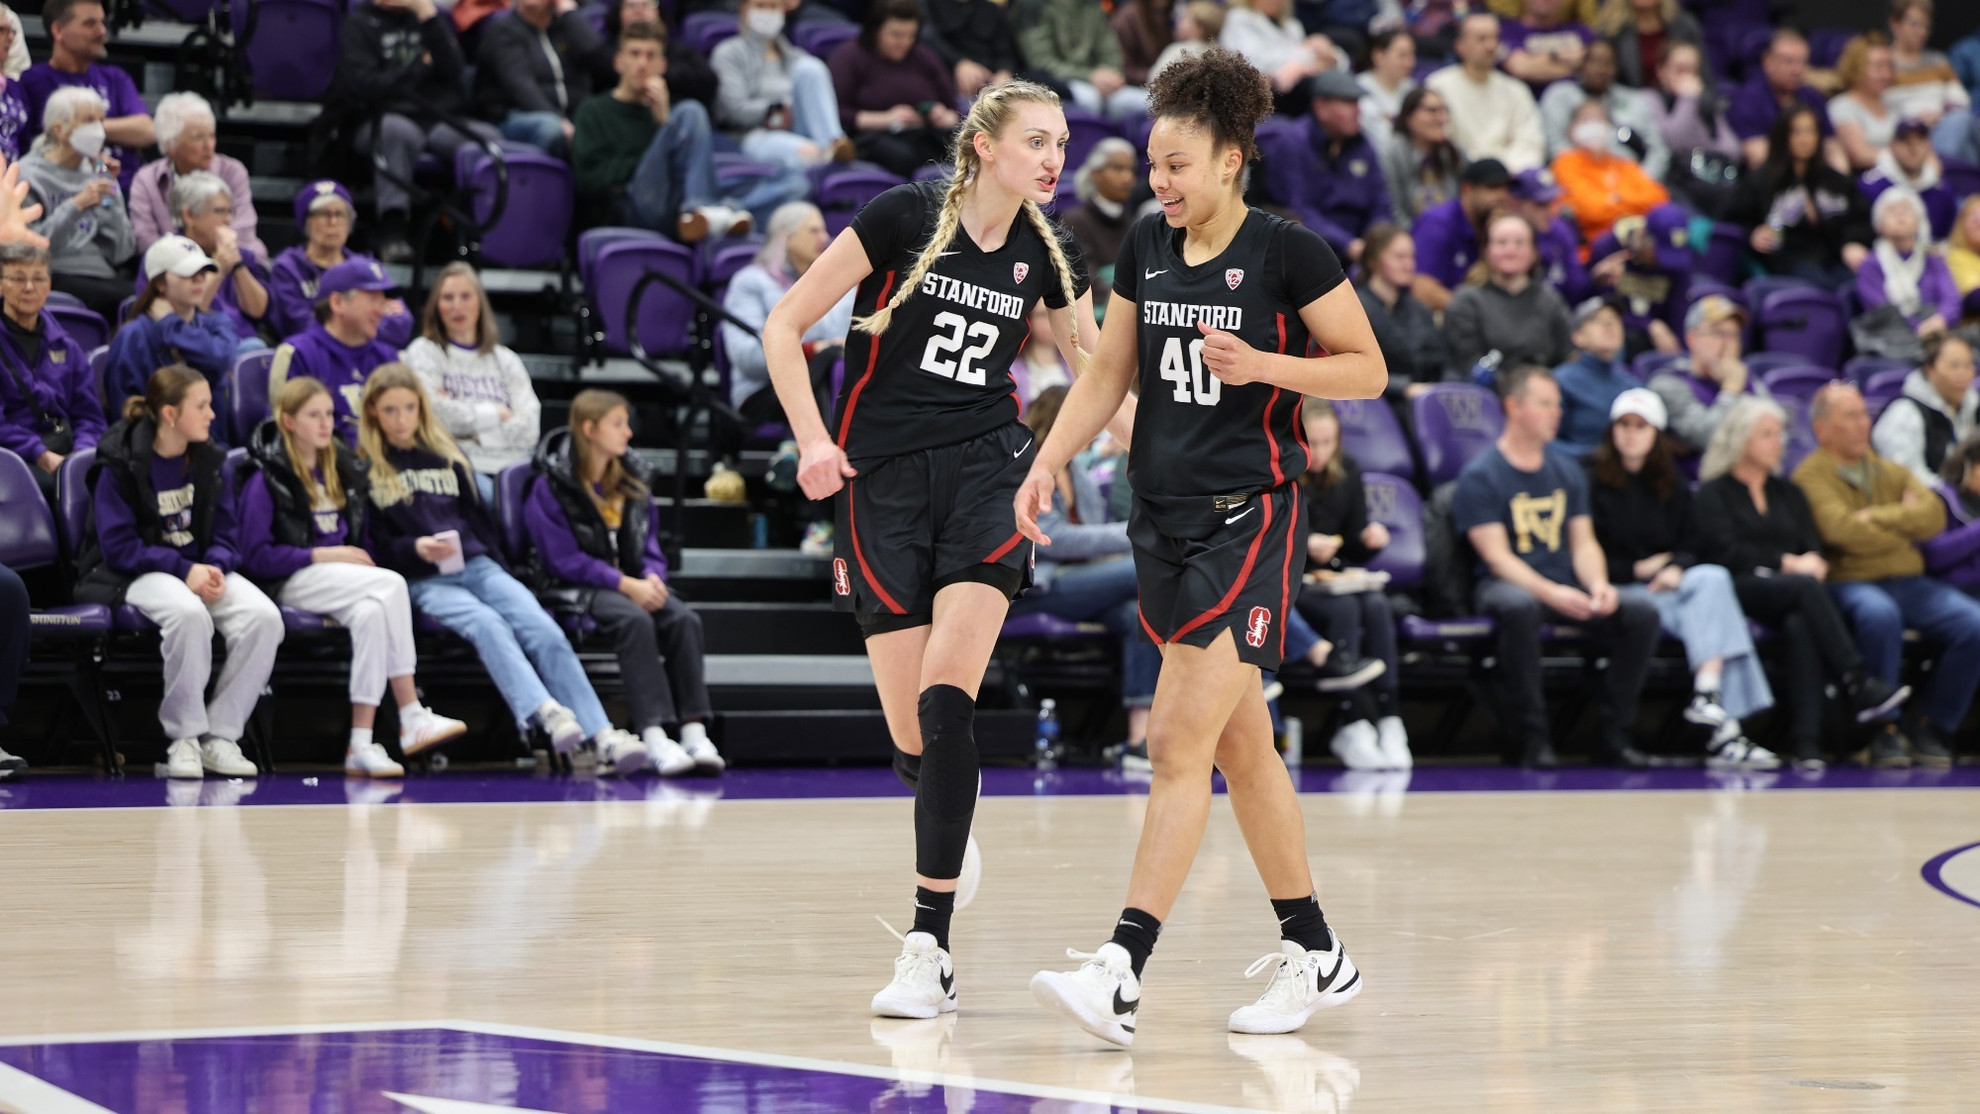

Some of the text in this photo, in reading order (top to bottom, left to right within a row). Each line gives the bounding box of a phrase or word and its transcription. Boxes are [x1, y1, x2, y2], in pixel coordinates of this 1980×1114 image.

[922, 272, 1025, 320] STANFORD
[1144, 301, 1243, 331] STANFORD
[920, 310, 1000, 386] 22
[1159, 337, 1222, 406] 40
